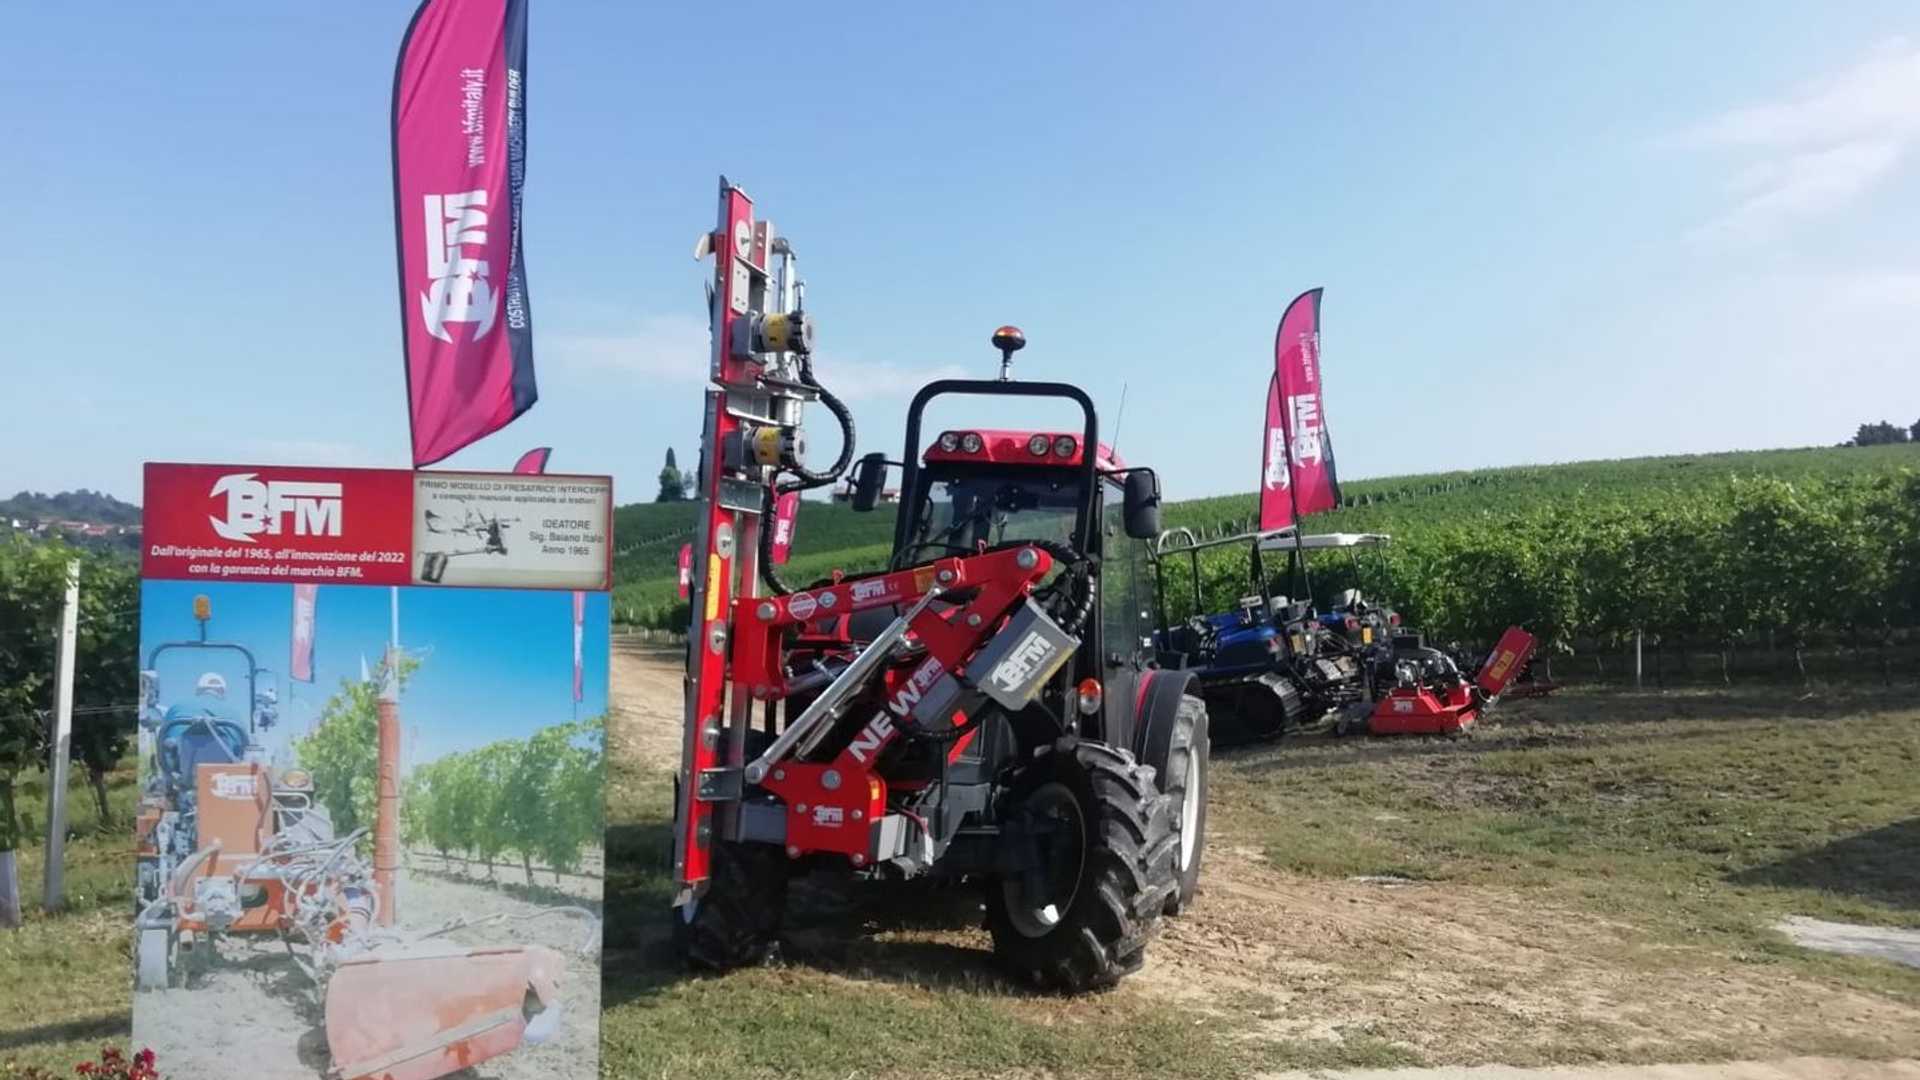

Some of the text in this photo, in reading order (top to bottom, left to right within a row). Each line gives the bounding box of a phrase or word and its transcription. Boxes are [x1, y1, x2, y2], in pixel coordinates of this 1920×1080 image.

[507, 69, 522, 109] BUILDER
[460, 67, 486, 168] www.bfmitaly.it
[420, 190, 499, 344] BFM
[1288, 394, 1321, 468] BFM
[420, 480, 448, 489] PRIMO
[449, 481, 492, 491] MODELLO
[504, 484, 555, 493] FRESATRICE
[209, 473, 343, 542] BFM
[542, 519, 592, 530] IDEATORE
[529, 530, 546, 544] Sig.
[151, 545, 405, 563] Dall'originale del 1965, all'innovazione del 2022
[541, 545, 591, 556] Anno 1965
[188, 562, 364, 578] con la garanzia del marchio BFM.
[850, 580, 886, 601] BFM
[991, 631, 1052, 691] BFM
[848, 679, 921, 763] NEW
[812, 805, 844, 824] BFM
